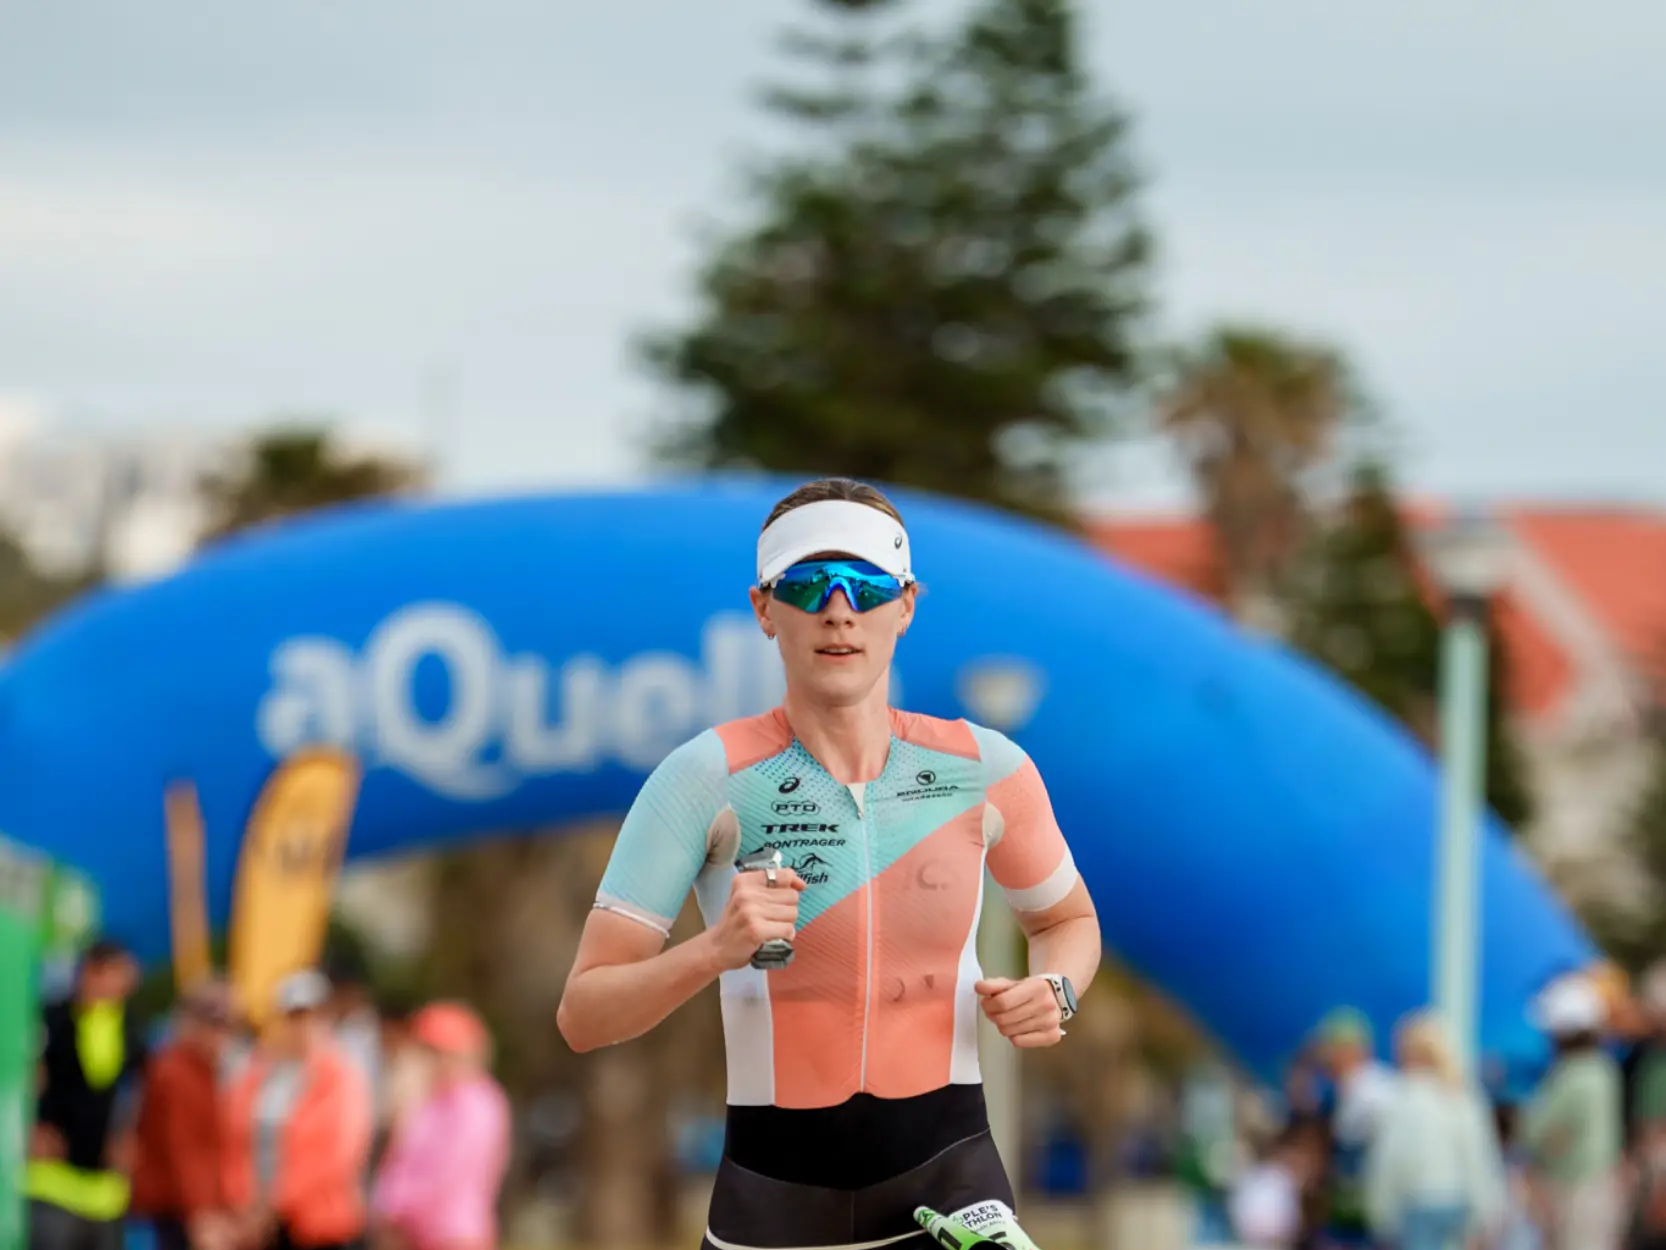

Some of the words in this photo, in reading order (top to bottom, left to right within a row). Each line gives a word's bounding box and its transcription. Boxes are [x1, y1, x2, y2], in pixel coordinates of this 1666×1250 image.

[256, 602, 787, 798] aQuell
[774, 803, 817, 813] PTO
[761, 824, 839, 835] TREK
[763, 838, 847, 850] BONTRAGER
[962, 1204, 999, 1221] PLE'S
[965, 1212, 1003, 1229] THLON
